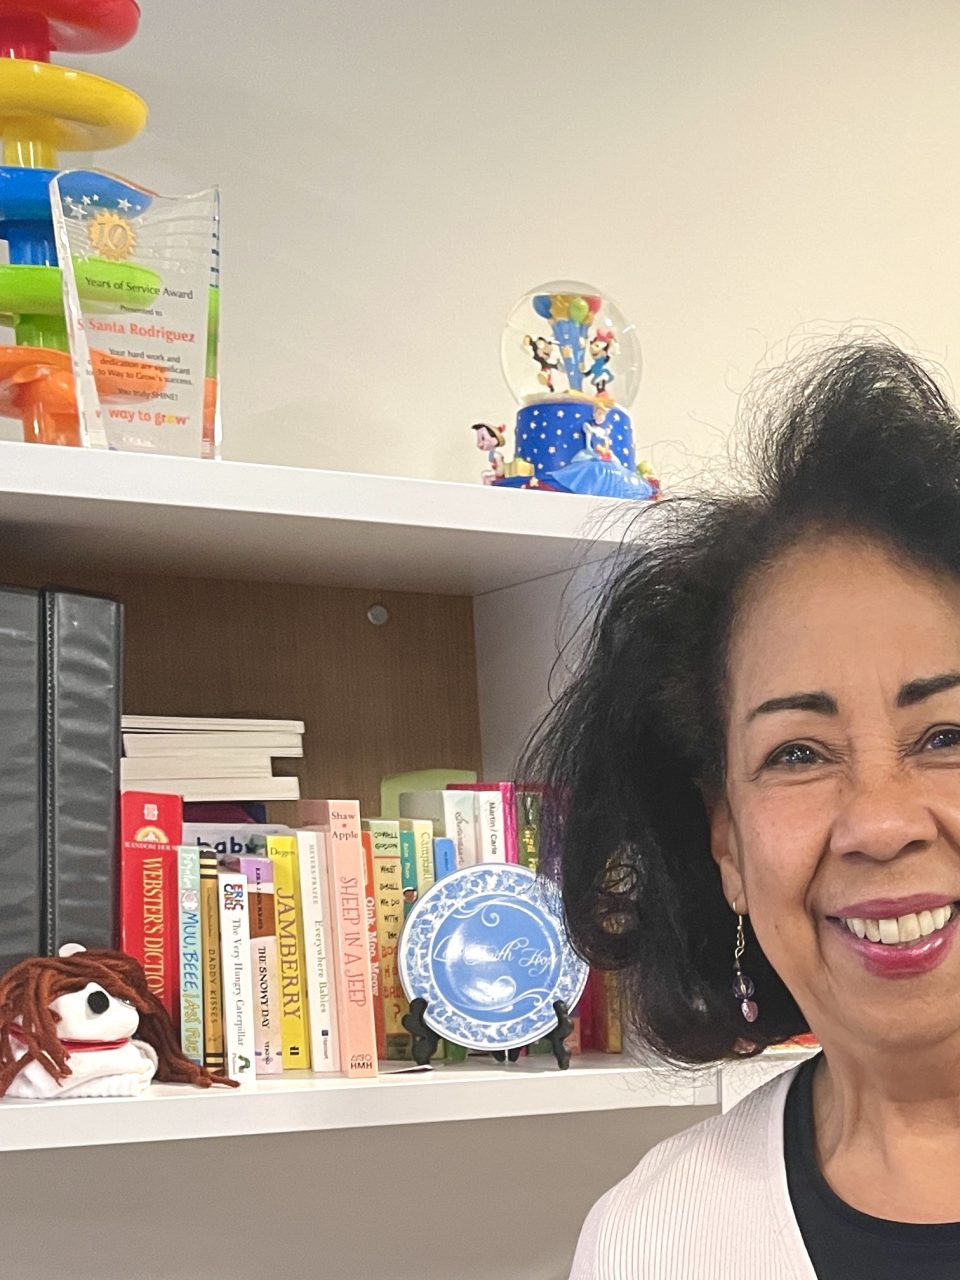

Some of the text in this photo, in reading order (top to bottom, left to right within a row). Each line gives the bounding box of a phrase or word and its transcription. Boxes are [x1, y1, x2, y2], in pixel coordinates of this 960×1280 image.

[85, 276, 193, 299] Years of Service Award
[130, 322, 195, 344] Rodriguez
[127, 350, 145, 359] hard
[146, 353, 165, 361] work
[109, 409, 188, 426] way to grow
[331, 811, 355, 820] Shaw
[488, 802, 496, 828] Martin
[124, 842, 156, 851] RANDOM
[331, 830, 359, 841] Apple
[489, 833, 497, 855] Carle
[420, 831, 433, 882] Campbell
[142, 857, 165, 935] WEBSTER'S
[223, 883, 234, 911] CARLE
[233, 884, 244, 911] ERIC
[276, 887, 301, 1020] JAMBERRY
[341, 874, 367, 1007] SHEEP IN A JEEP
[182, 949, 200, 993] BEEE,
[314, 920, 329, 1013] Everywhere Babies
[208, 948, 218, 1024] DADDY KISSES
[232, 917, 246, 1046] The Very Hungry Caterpillar
[257, 946, 271, 1029] THE SNOWY DAY
[350, 1061, 373, 1070] HMH
